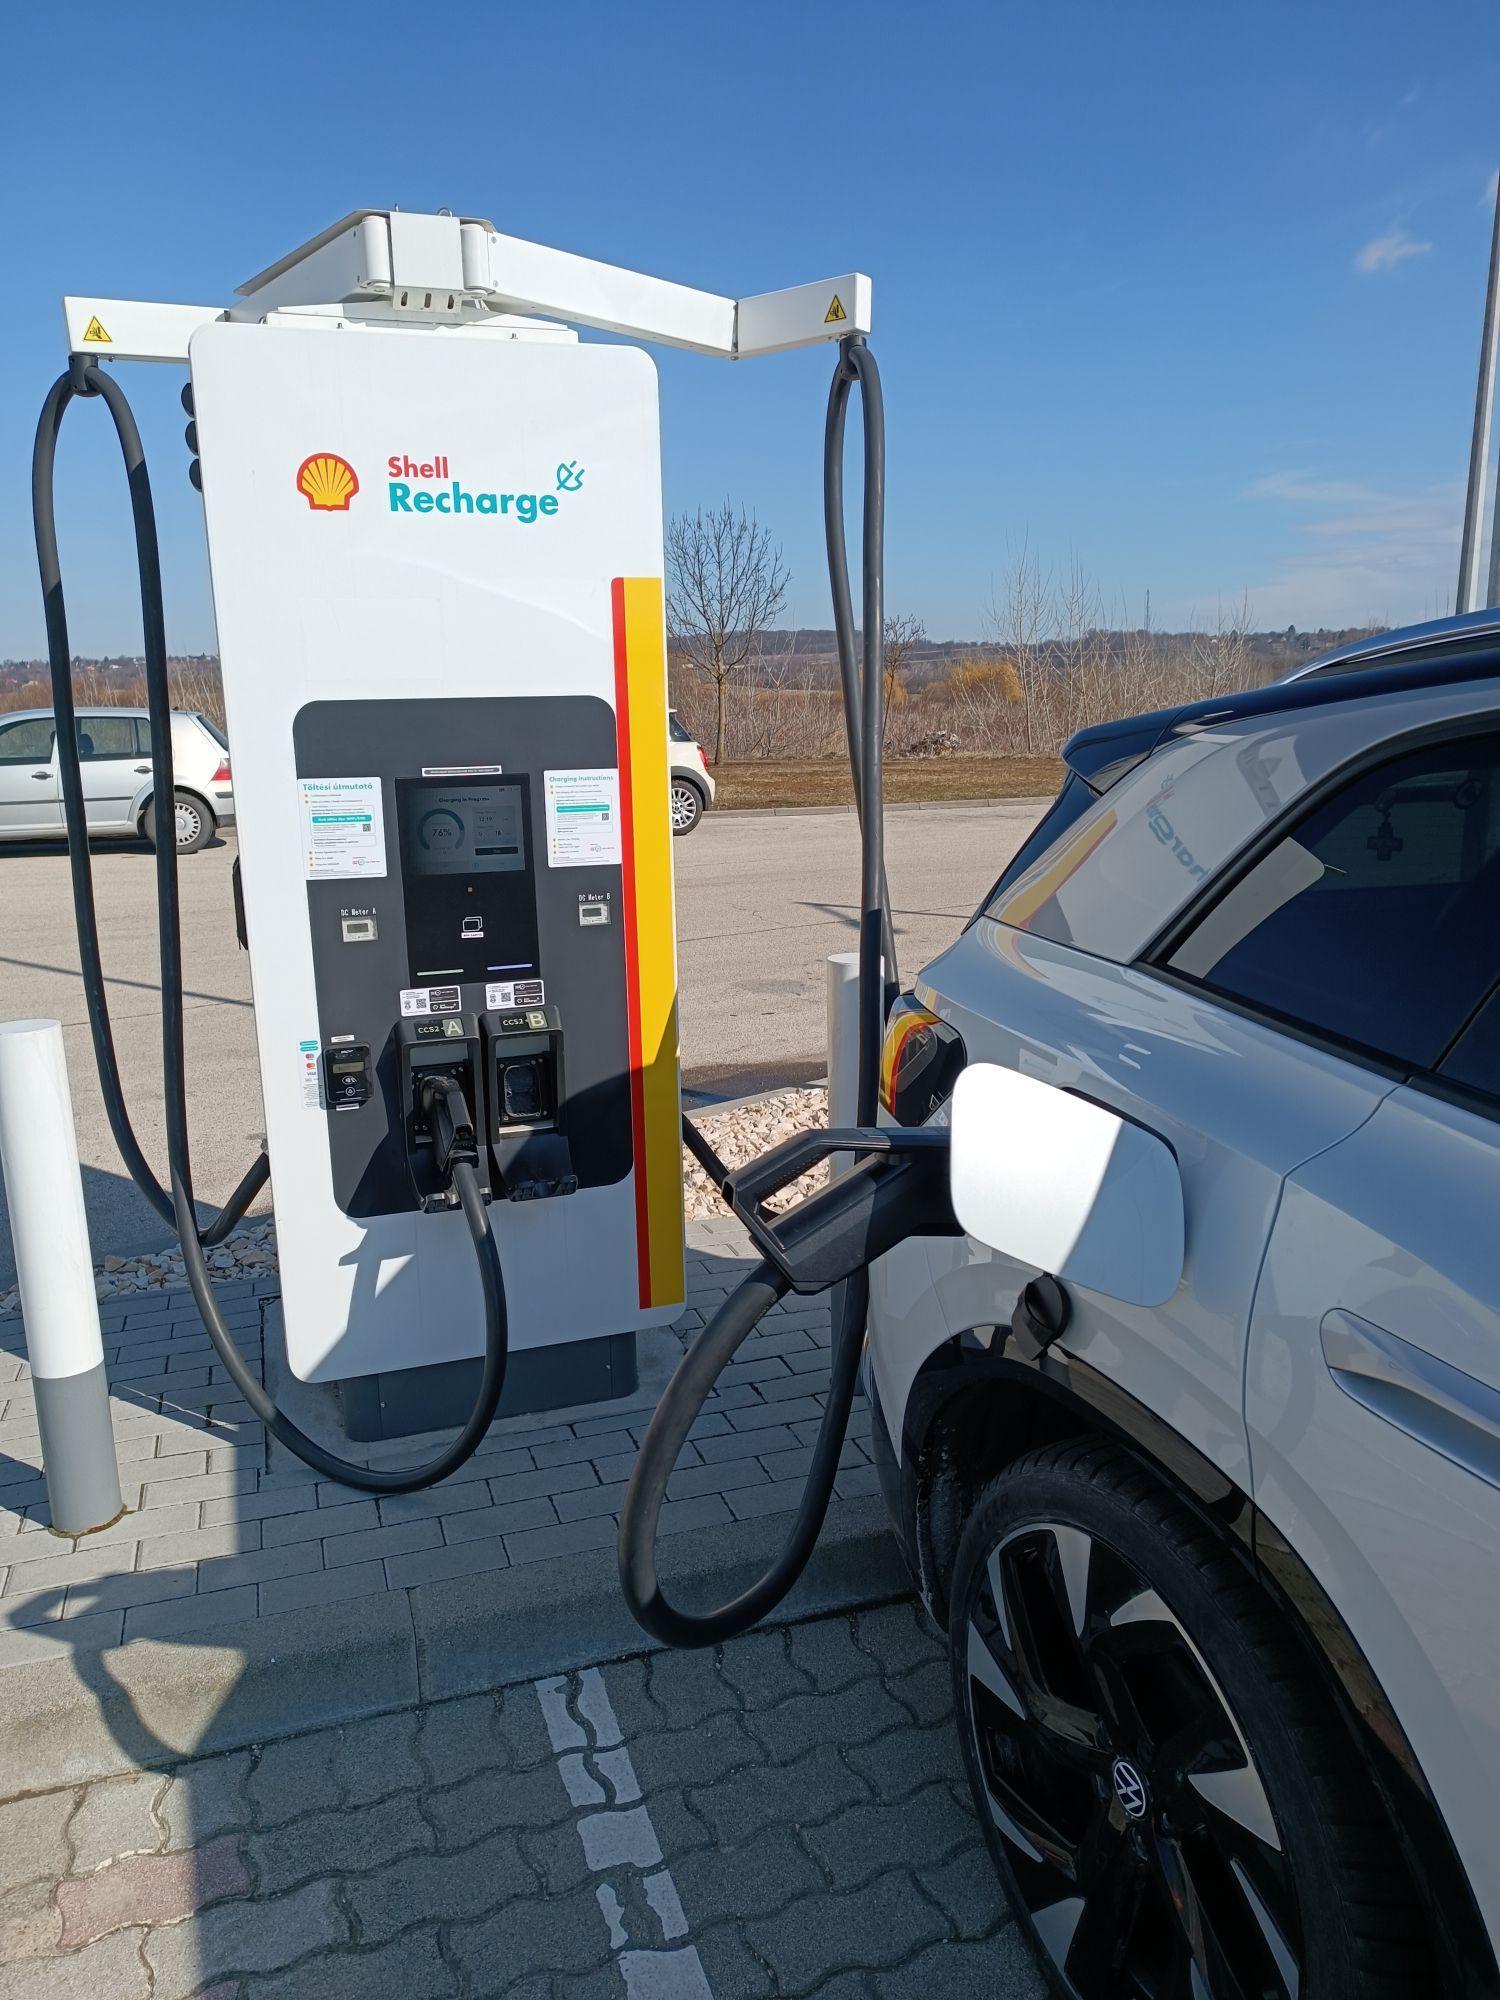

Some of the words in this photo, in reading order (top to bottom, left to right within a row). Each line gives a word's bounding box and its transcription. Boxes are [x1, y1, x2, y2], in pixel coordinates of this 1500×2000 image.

[388, 455, 449, 479] Shell
[388, 482, 559, 524] Recharge
[340, 908, 349, 916] DC
[351, 908, 369, 916] Meter
[417, 1025, 440, 1034] CCS2
[447, 1020, 463, 1035] A
[502, 1018, 524, 1026] CCS2
[530, 1013, 545, 1027] B
